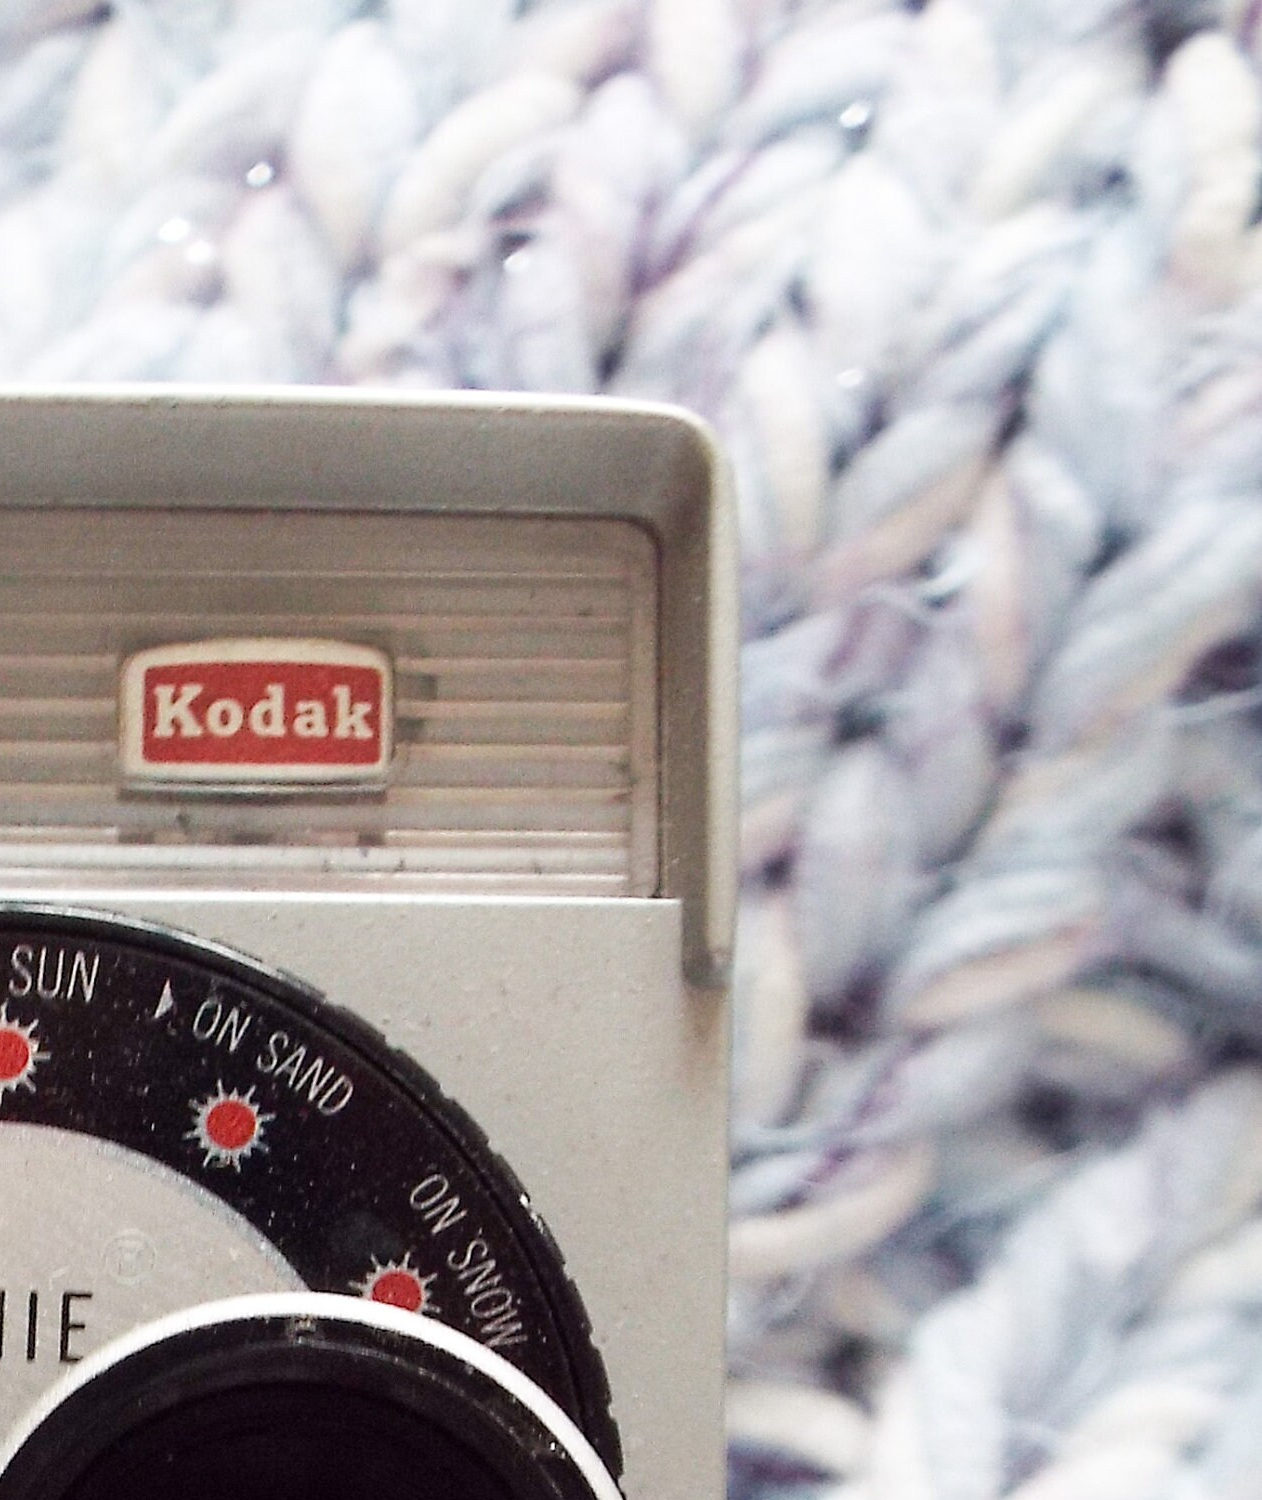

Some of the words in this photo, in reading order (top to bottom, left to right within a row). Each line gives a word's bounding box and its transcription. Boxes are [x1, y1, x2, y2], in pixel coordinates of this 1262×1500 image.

[153, 682, 374, 740] Kodak
[8, 943, 101, 1003] SUN
[192, 998, 251, 1053] ON
[256, 1031, 355, 1116] SAND
[410, 1174, 468, 1235] ON
[447, 1239, 528, 1347] SNOW
